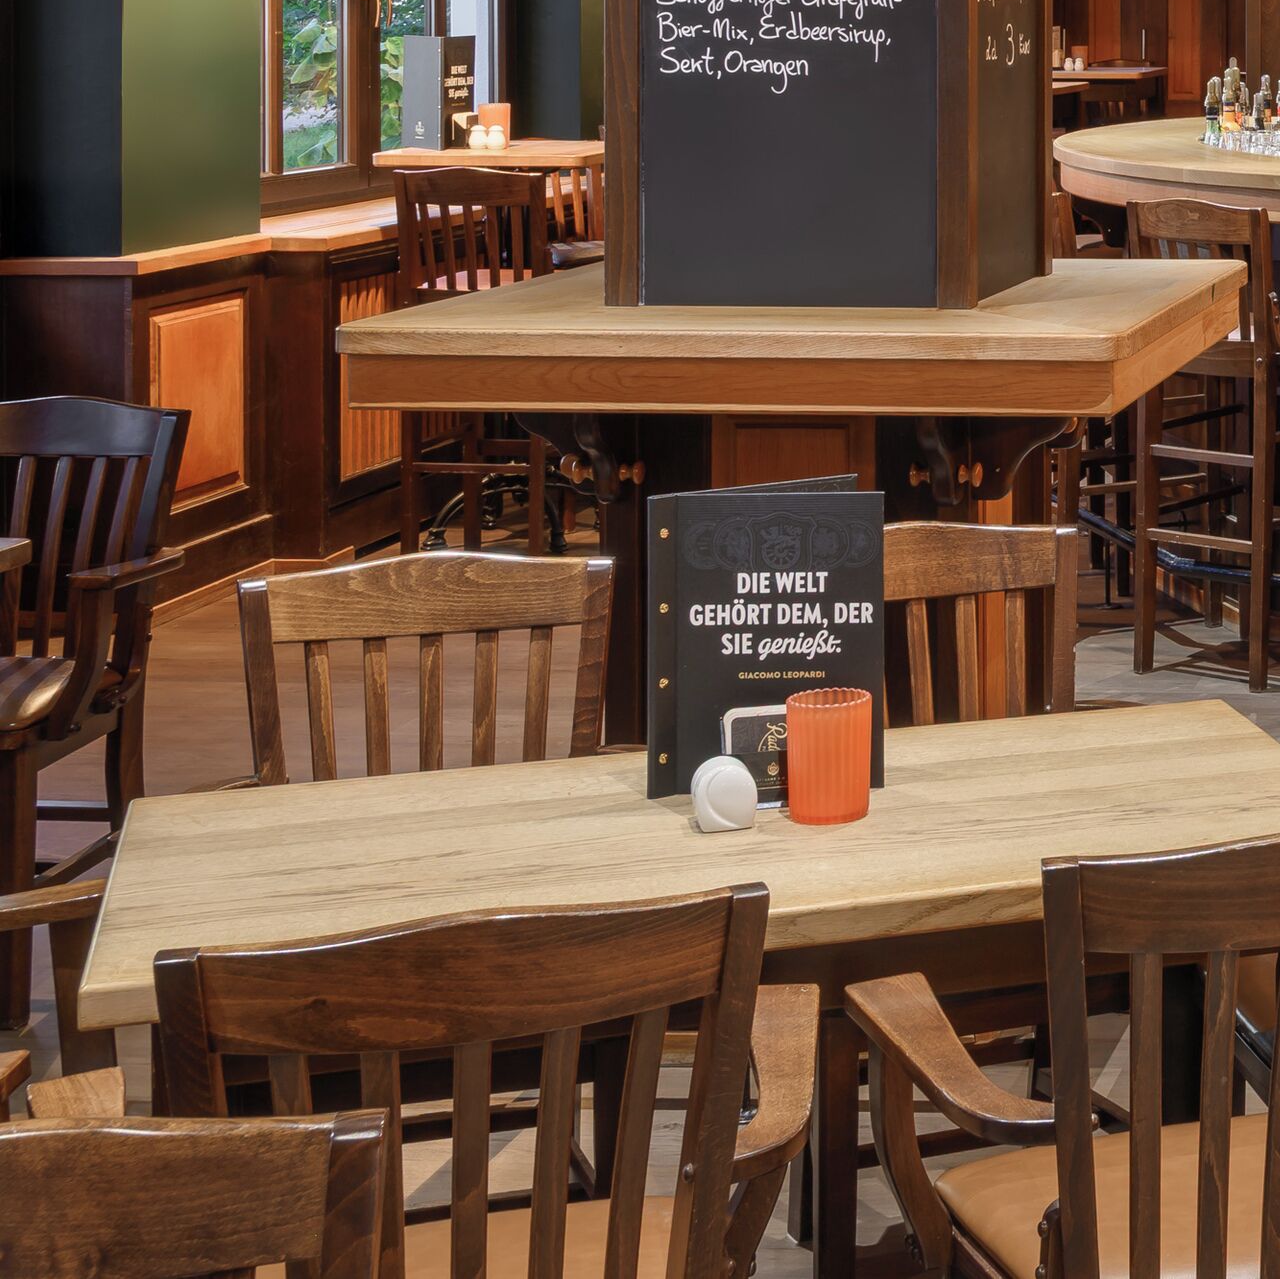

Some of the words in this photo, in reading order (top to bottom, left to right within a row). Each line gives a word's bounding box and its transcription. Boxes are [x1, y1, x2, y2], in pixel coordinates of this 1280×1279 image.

[656, 11, 754, 45] Bier-Mix,
[759, 10, 891, 62] Erdbeersirup,
[1006, 23, 1015, 66] 3
[724, 50, 808, 94] Orangen
[737, 572, 771, 594] DIE
[776, 571, 828, 593] WELT
[689, 599, 772, 626] GEHÖRT
[777, 603, 829, 628] DEM,
[834, 602, 874, 624] DER
[721, 633, 753, 656] SIE
[758, 630, 842, 660] genießt.
[738, 671, 781, 680] GIACOMO
[783, 670, 826, 679] LEOPARDI
